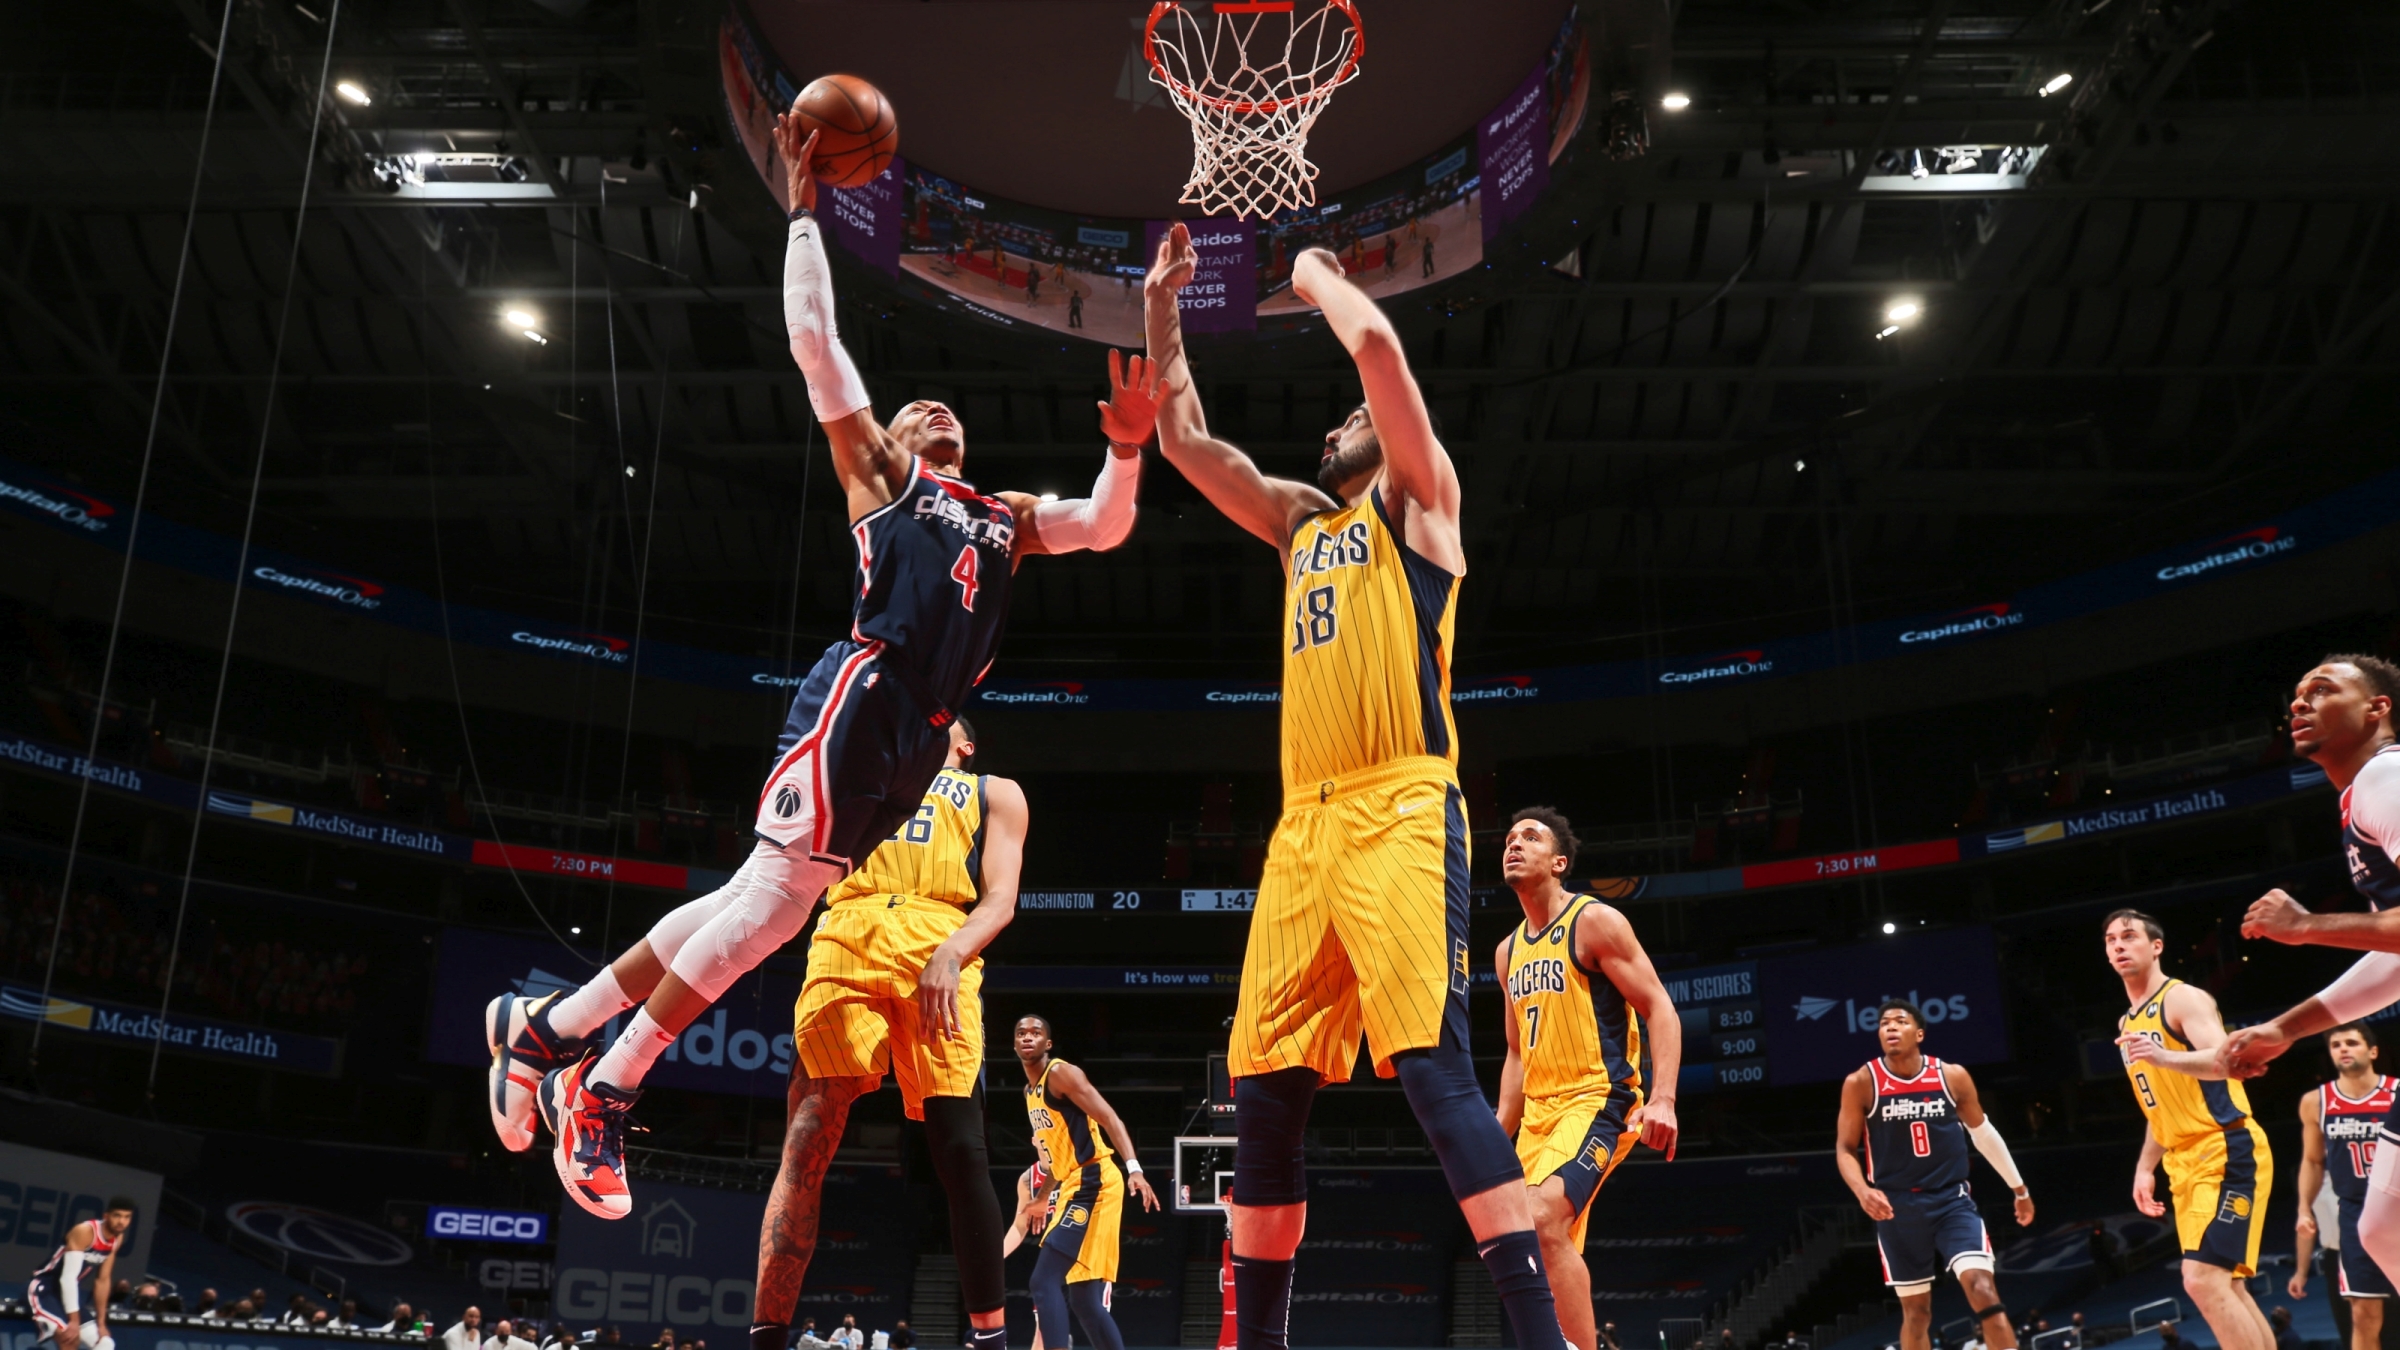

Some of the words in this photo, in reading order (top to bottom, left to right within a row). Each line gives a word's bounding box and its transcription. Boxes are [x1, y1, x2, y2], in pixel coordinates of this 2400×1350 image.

[1504, 85, 1540, 129] leidos
[1484, 105, 1541, 169] IMPORTANT
[1500, 136, 1530, 171] WORK
[1498, 149, 1533, 188] NEVER
[1502, 163, 1534, 201] STOPS
[832, 187, 876, 223] NEVER
[847, 184, 873, 207] ORK
[834, 204, 875, 237] STOPS
[1192, 233, 1243, 247] eidos
[1197, 254, 1244, 267] RTANT
[1193, 270, 1223, 281] ORK
[1176, 284, 1226, 296] NEVER
[1178, 297, 1226, 309] STOPS
[964, 301, 1013, 325] leidos
[0, 481, 108, 532] pitalOne
[951, 544, 979, 613] 4
[1206, 690, 1282, 703] Capital
[1451, 686, 1538, 702] pitalOne
[0, 740, 68, 771] edStar
[71, 757, 142, 791] Health
[888, 806, 934, 843] 6
[2066, 807, 2149, 837] MedStar
[2153, 789, 2226, 819] Health
[296, 810, 378, 841] MedStar
[381, 822, 445, 854] Health
[552, 855, 586, 872] 7:30
[590, 860, 613, 875] PM
[1815, 857, 1849, 874] 7:30
[1854, 855, 1877, 870] PM
[1020, 893, 1095, 909] WASHINGTON
[1112, 891, 1141, 909] 20
[1186, 900, 1192, 908] 1
[1481, 897, 1486, 906] 1
[1125, 972, 1148, 984] It's
[1152, 972, 1184, 984] how
[1188, 974, 1210, 983] we
[1664, 981, 1690, 1003] WN
[1693, 972, 1751, 1001] SCORES
[1720, 1010, 1753, 1027] 8:30
[1845, 989, 1970, 1033] leos
[95, 1010, 199, 1045] MedStar
[202, 1026, 279, 1058] Health
[1527, 1006, 1540, 1048] 7
[1722, 1038, 1756, 1055] 9:00
[1720, 1066, 1763, 1084] 10:00
[2136, 1073, 2157, 1108] 9
[1882, 1097, 1946, 1118] district
[1909, 1120, 1932, 1158] 8
[2326, 1117, 2383, 1136] distri
[433, 1211, 541, 1239] GEICO
[1301, 1240, 1432, 1251] pitalOne
[479, 1259, 550, 1290] GEI
[556, 1268, 756, 1327] GEICO
[1293, 1292, 1438, 1304] pitalOne
